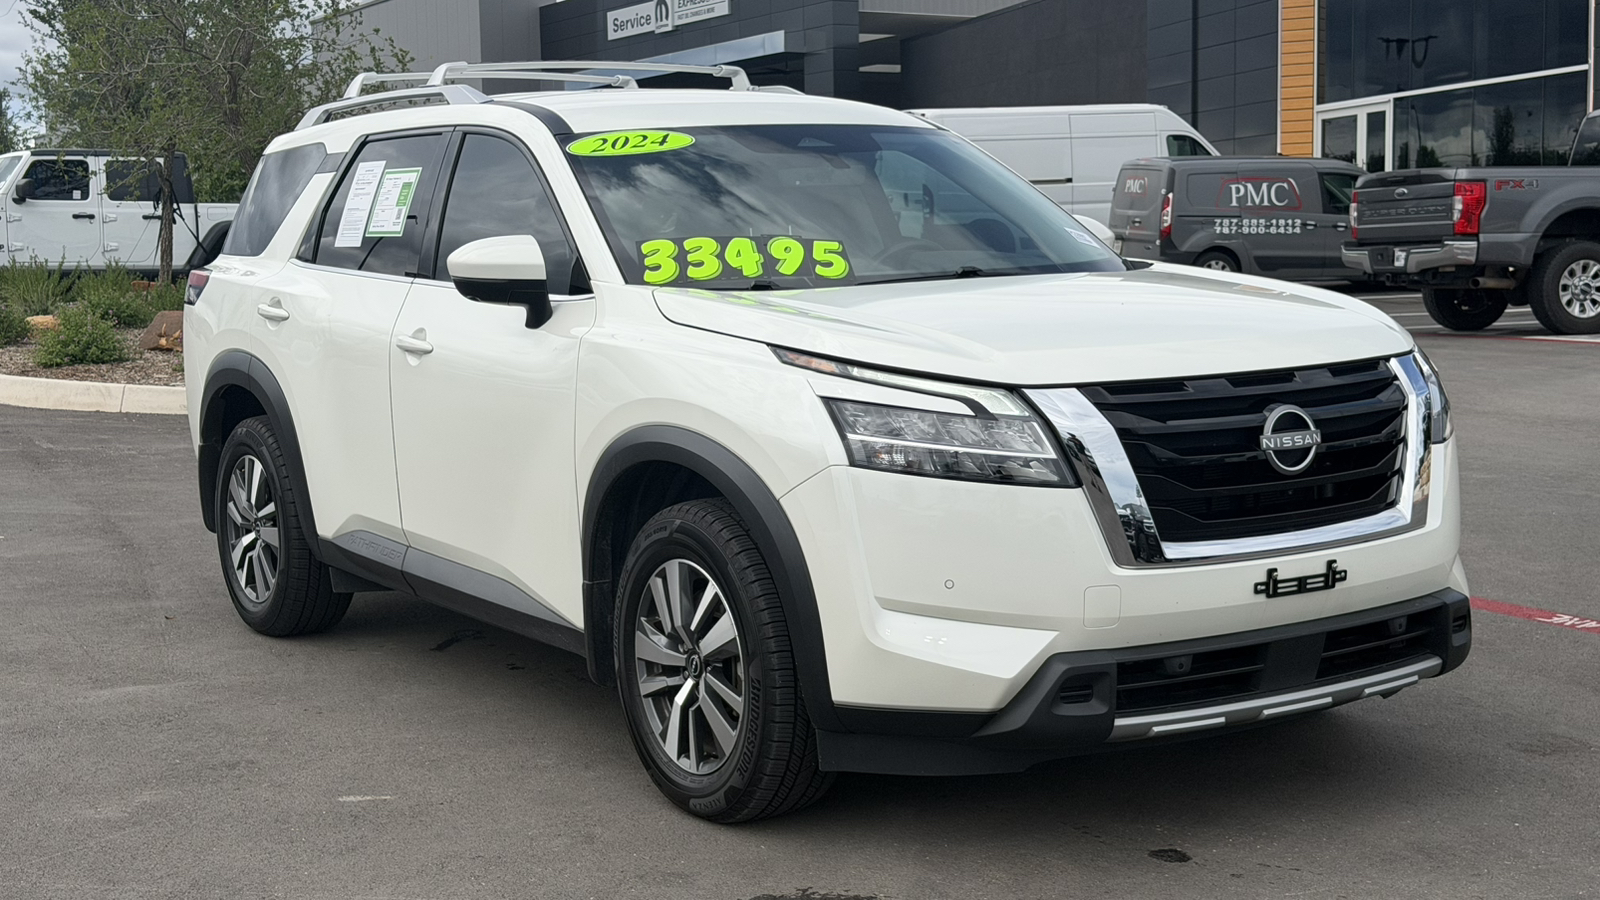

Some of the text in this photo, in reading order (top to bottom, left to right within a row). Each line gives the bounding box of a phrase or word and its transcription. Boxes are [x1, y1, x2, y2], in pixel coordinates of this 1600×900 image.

[612, 13, 652, 33] Service
[589, 133, 671, 154] 2024
[1124, 178, 1145, 194] PMC
[1229, 181, 1289, 207] PMC
[1495, 179, 1539, 191] FX4
[640, 237, 849, 284] 33495
[1262, 432, 1321, 448] NISSAN
[737, 676, 762, 781] BRIDGESTONE
